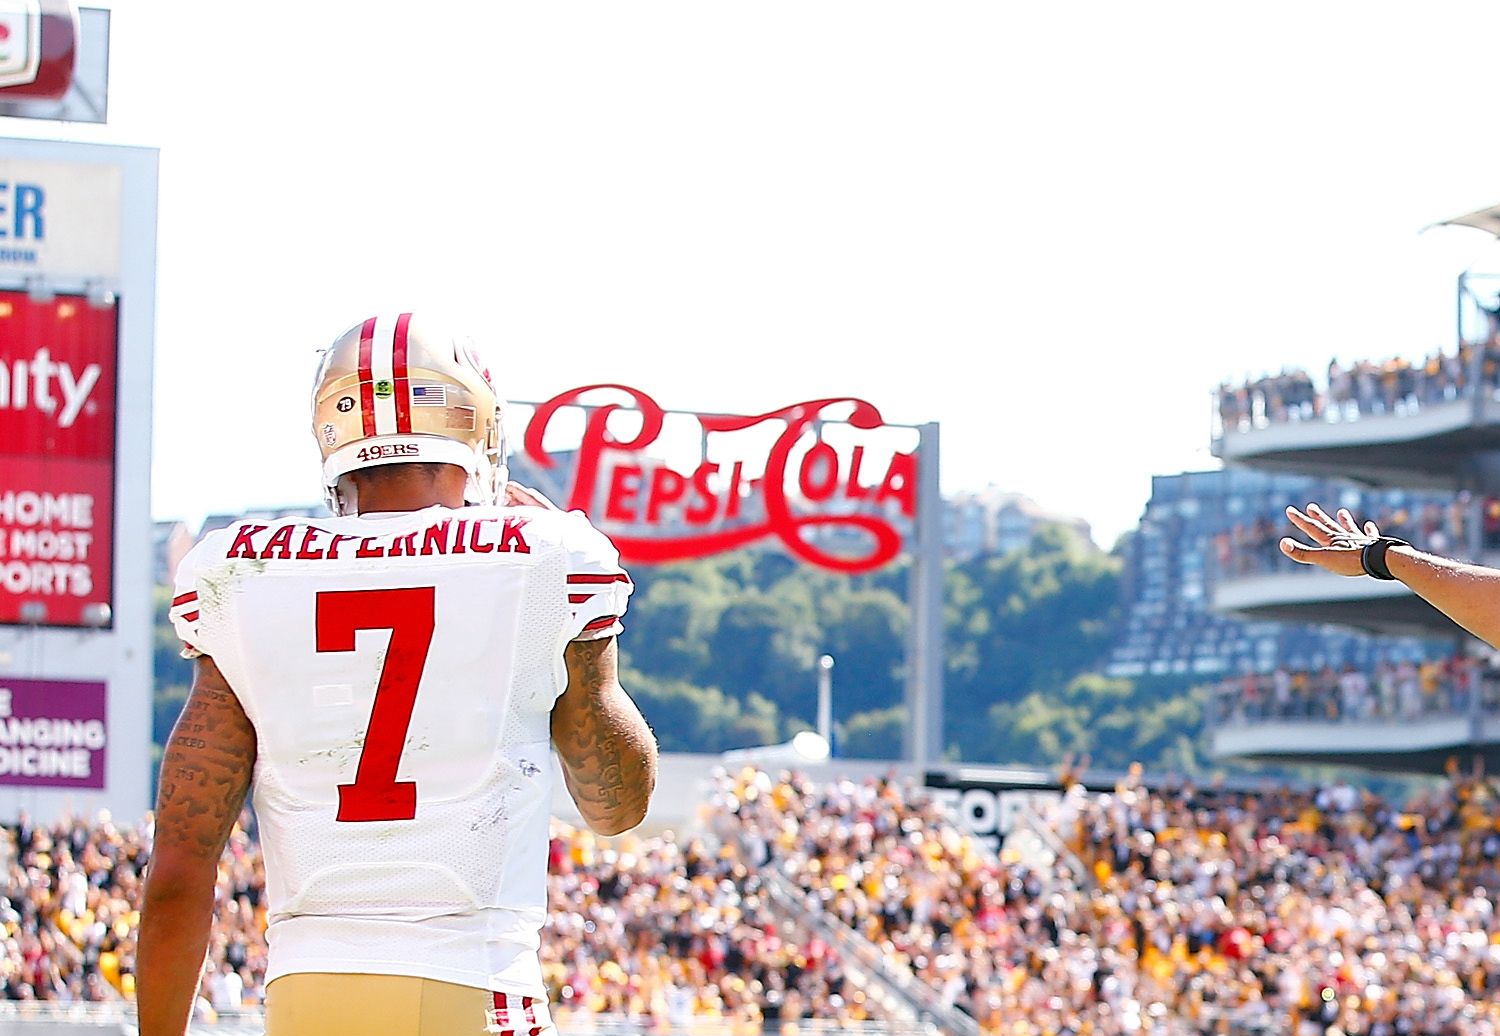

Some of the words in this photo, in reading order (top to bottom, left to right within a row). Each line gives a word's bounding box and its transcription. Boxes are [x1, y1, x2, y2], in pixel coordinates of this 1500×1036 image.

[0, 183, 44, 239] R
[340, 398, 352, 411] 79
[357, 443, 419, 462] 49ERS
[10, 529, 92, 561] MOST
[0, 560, 93, 596] ORTS
[315, 586, 436, 823] 7
